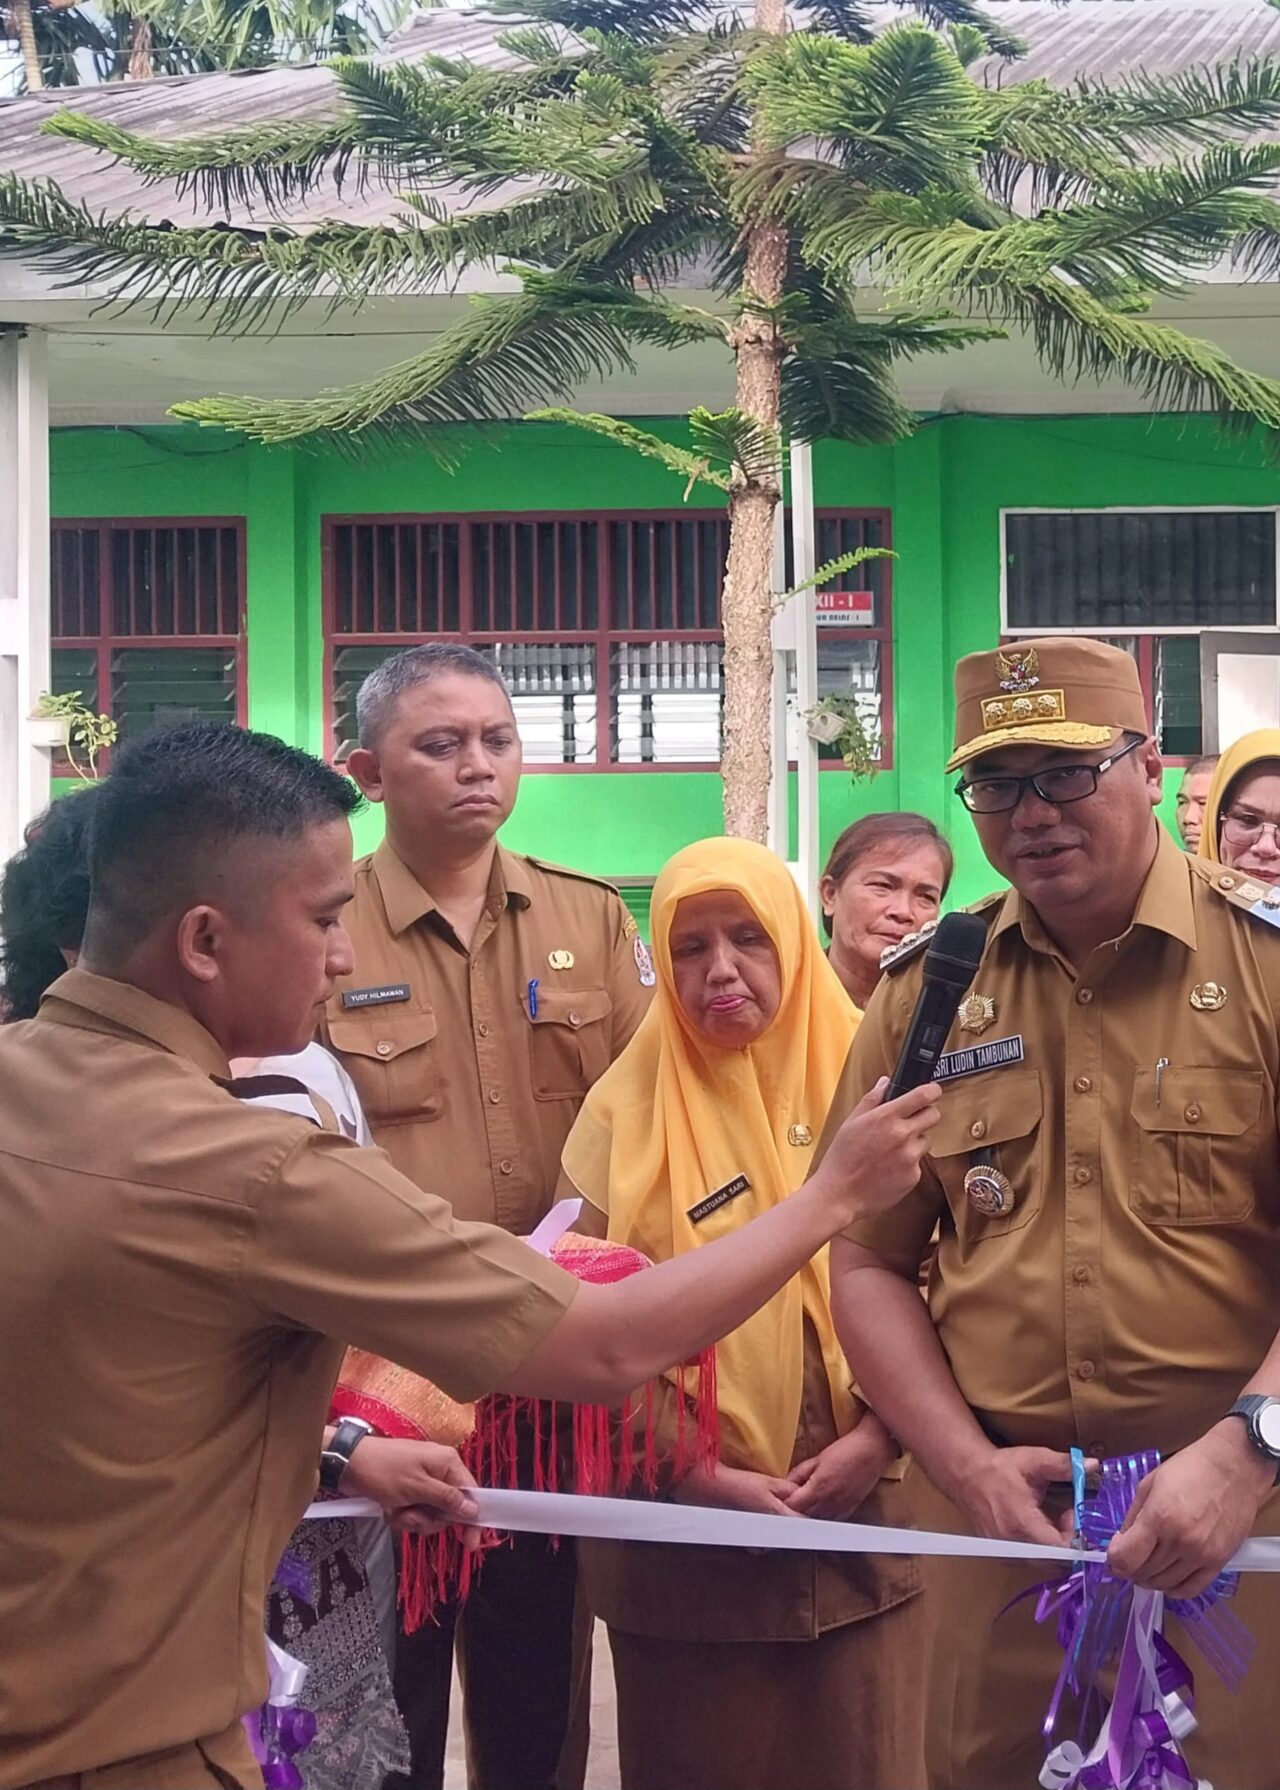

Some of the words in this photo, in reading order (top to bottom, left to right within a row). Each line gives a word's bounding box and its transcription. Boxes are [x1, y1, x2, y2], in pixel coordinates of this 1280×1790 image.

[351, 993, 368, 1002] YUDY
[369, 989, 404, 999] HILMAWAN
[950, 1052, 975, 1074] LUDIN
[976, 1039, 1020, 1067] TAMBUNAN
[693, 1193, 728, 1219] MASTUANA
[728, 1181, 745, 1195] SARI
